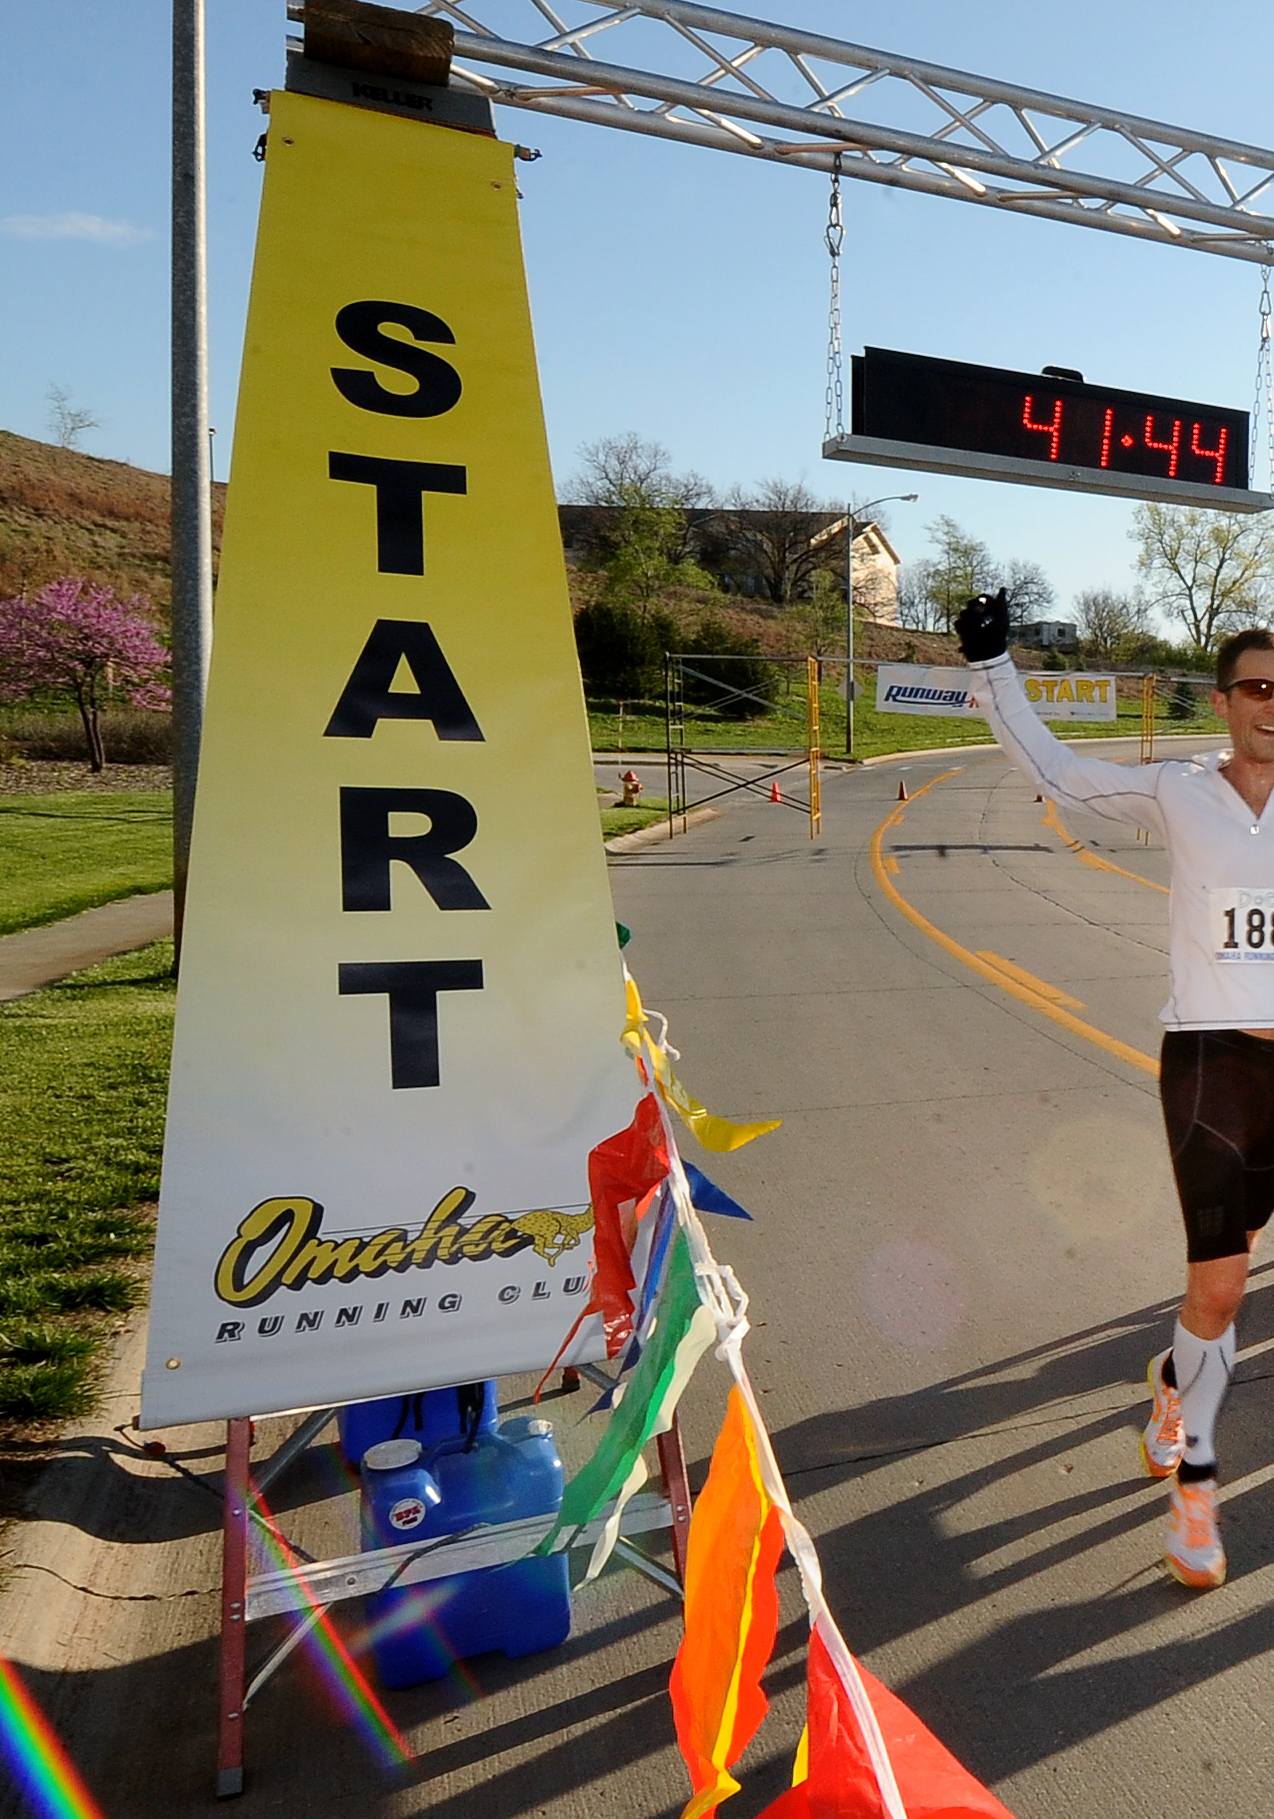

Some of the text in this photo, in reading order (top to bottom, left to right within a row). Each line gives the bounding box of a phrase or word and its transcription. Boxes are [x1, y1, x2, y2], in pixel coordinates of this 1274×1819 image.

[352, 82, 433, 111] KELLER
[323, 299, 492, 1089] START
[884, 684, 969, 708] Runway
[1024, 679, 1111, 703] START
[214, 1185, 532, 1309] Omaha
[214, 1275, 586, 1344] RUNNING CLU
